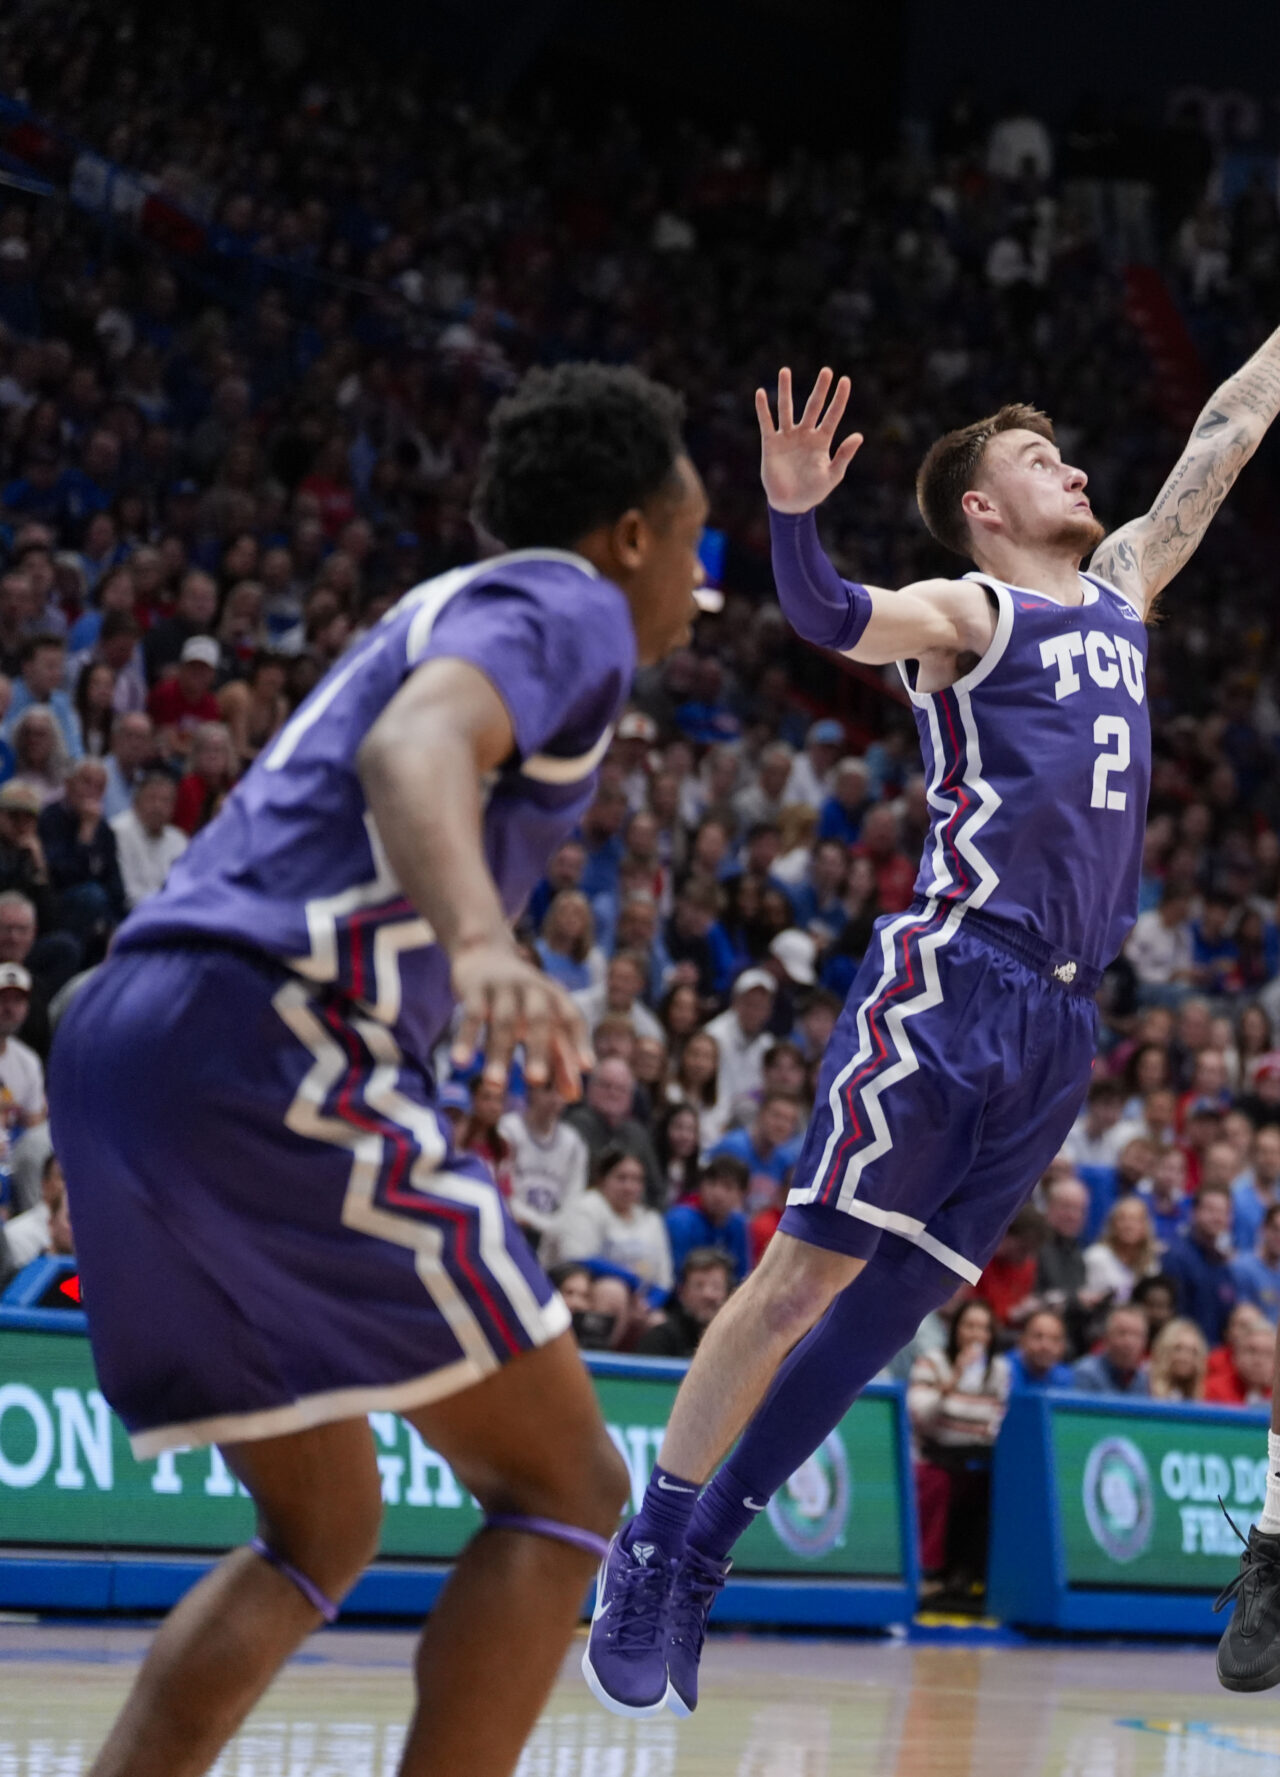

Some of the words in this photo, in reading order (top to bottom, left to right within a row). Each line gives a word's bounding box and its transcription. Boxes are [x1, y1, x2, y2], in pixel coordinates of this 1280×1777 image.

[1038, 629, 1145, 706] TCU
[1089, 714, 1131, 812] 2
[1161, 1452, 1231, 1502] OLD
